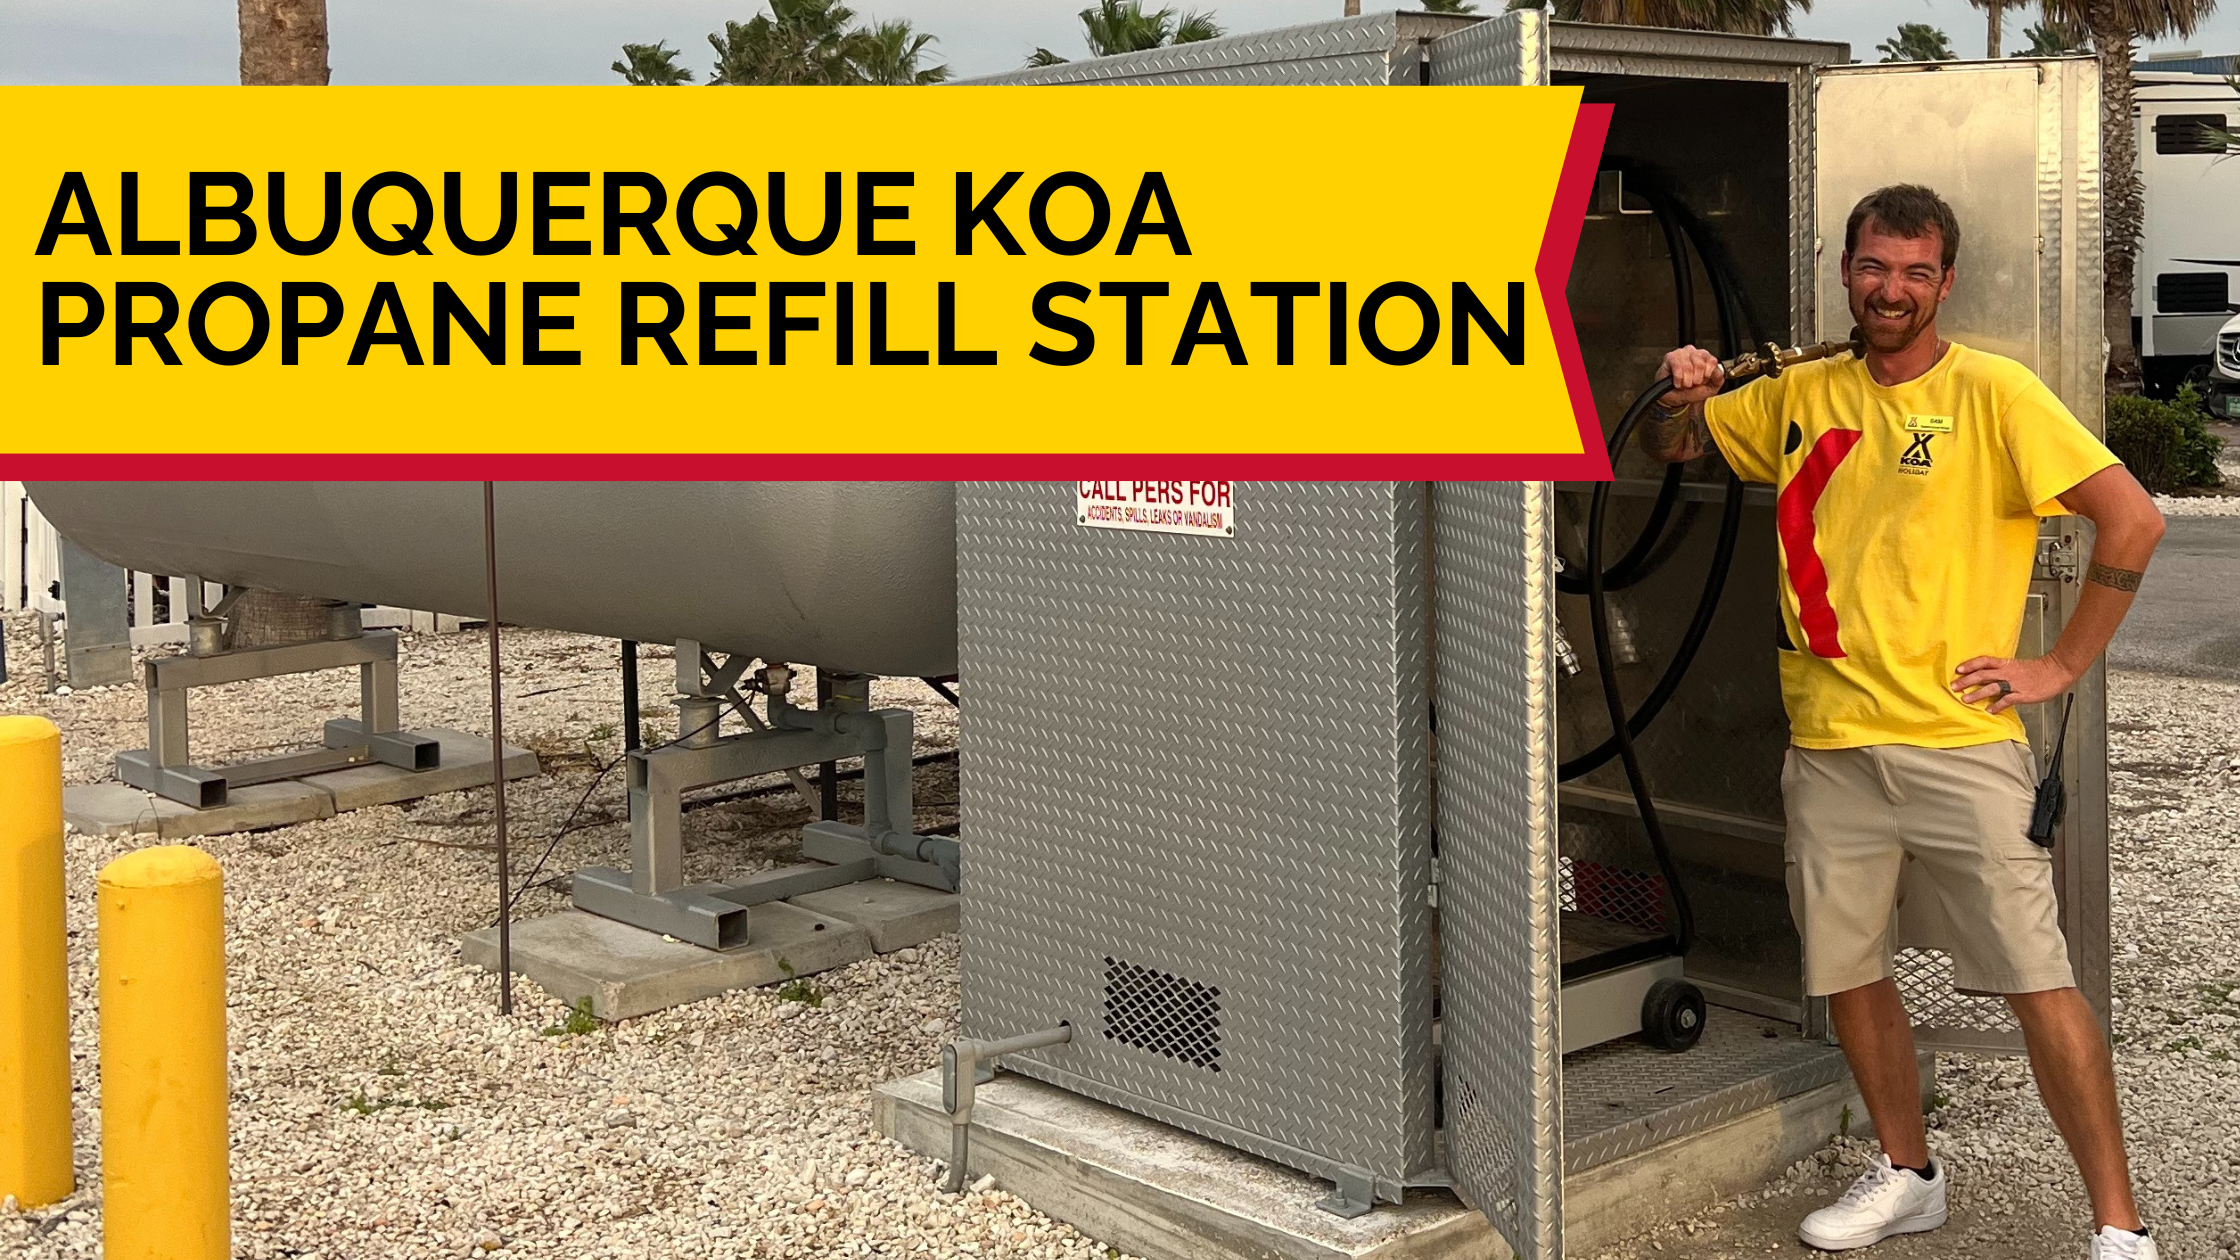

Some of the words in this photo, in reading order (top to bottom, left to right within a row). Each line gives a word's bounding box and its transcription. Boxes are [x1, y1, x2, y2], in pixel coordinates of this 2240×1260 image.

[1900, 457, 1931, 467] KOA
[1080, 481, 1126, 501] CALL
[1133, 481, 1183, 504] PERS
[1190, 481, 1231, 507] FOR
[1088, 505, 1123, 523] ACCIDENTS,
[1125, 508, 1149, 526] SPILLS,
[1150, 508, 1172, 525] LEAKS
[1173, 510, 1183, 525] OR
[1184, 512, 1222, 529] VANDALISM
